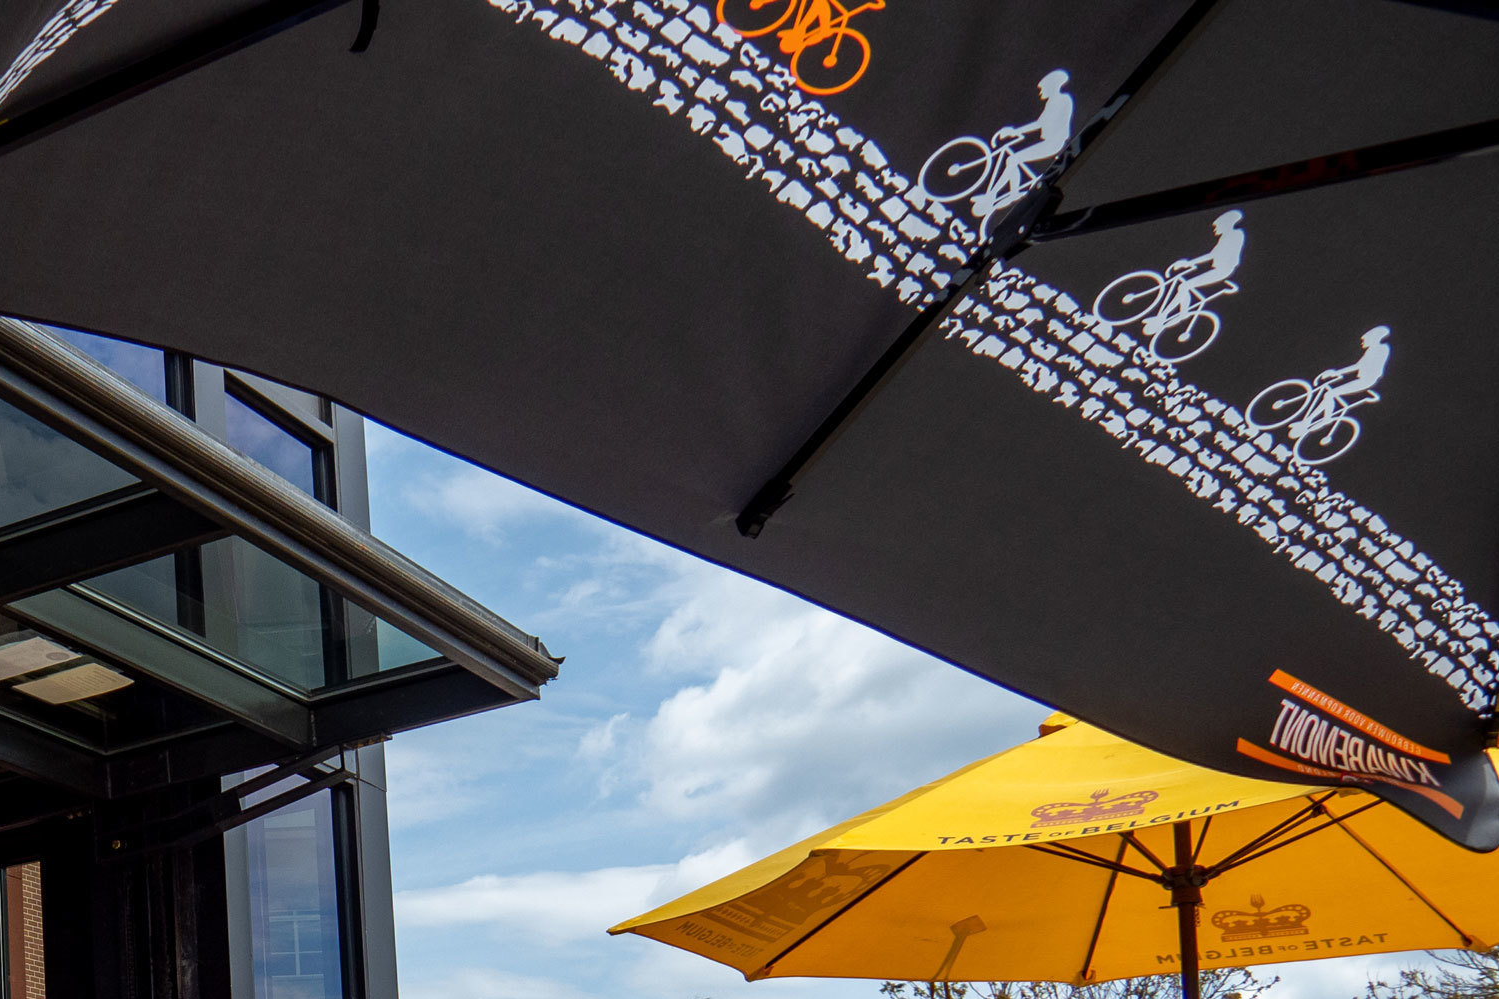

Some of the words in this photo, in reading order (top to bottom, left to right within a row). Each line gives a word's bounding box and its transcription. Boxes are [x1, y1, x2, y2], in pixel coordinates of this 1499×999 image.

[937, 831, 1042, 845] TASTE
[1048, 830, 1076, 838] OF
[1080, 799, 1240, 835] BELGIUM
